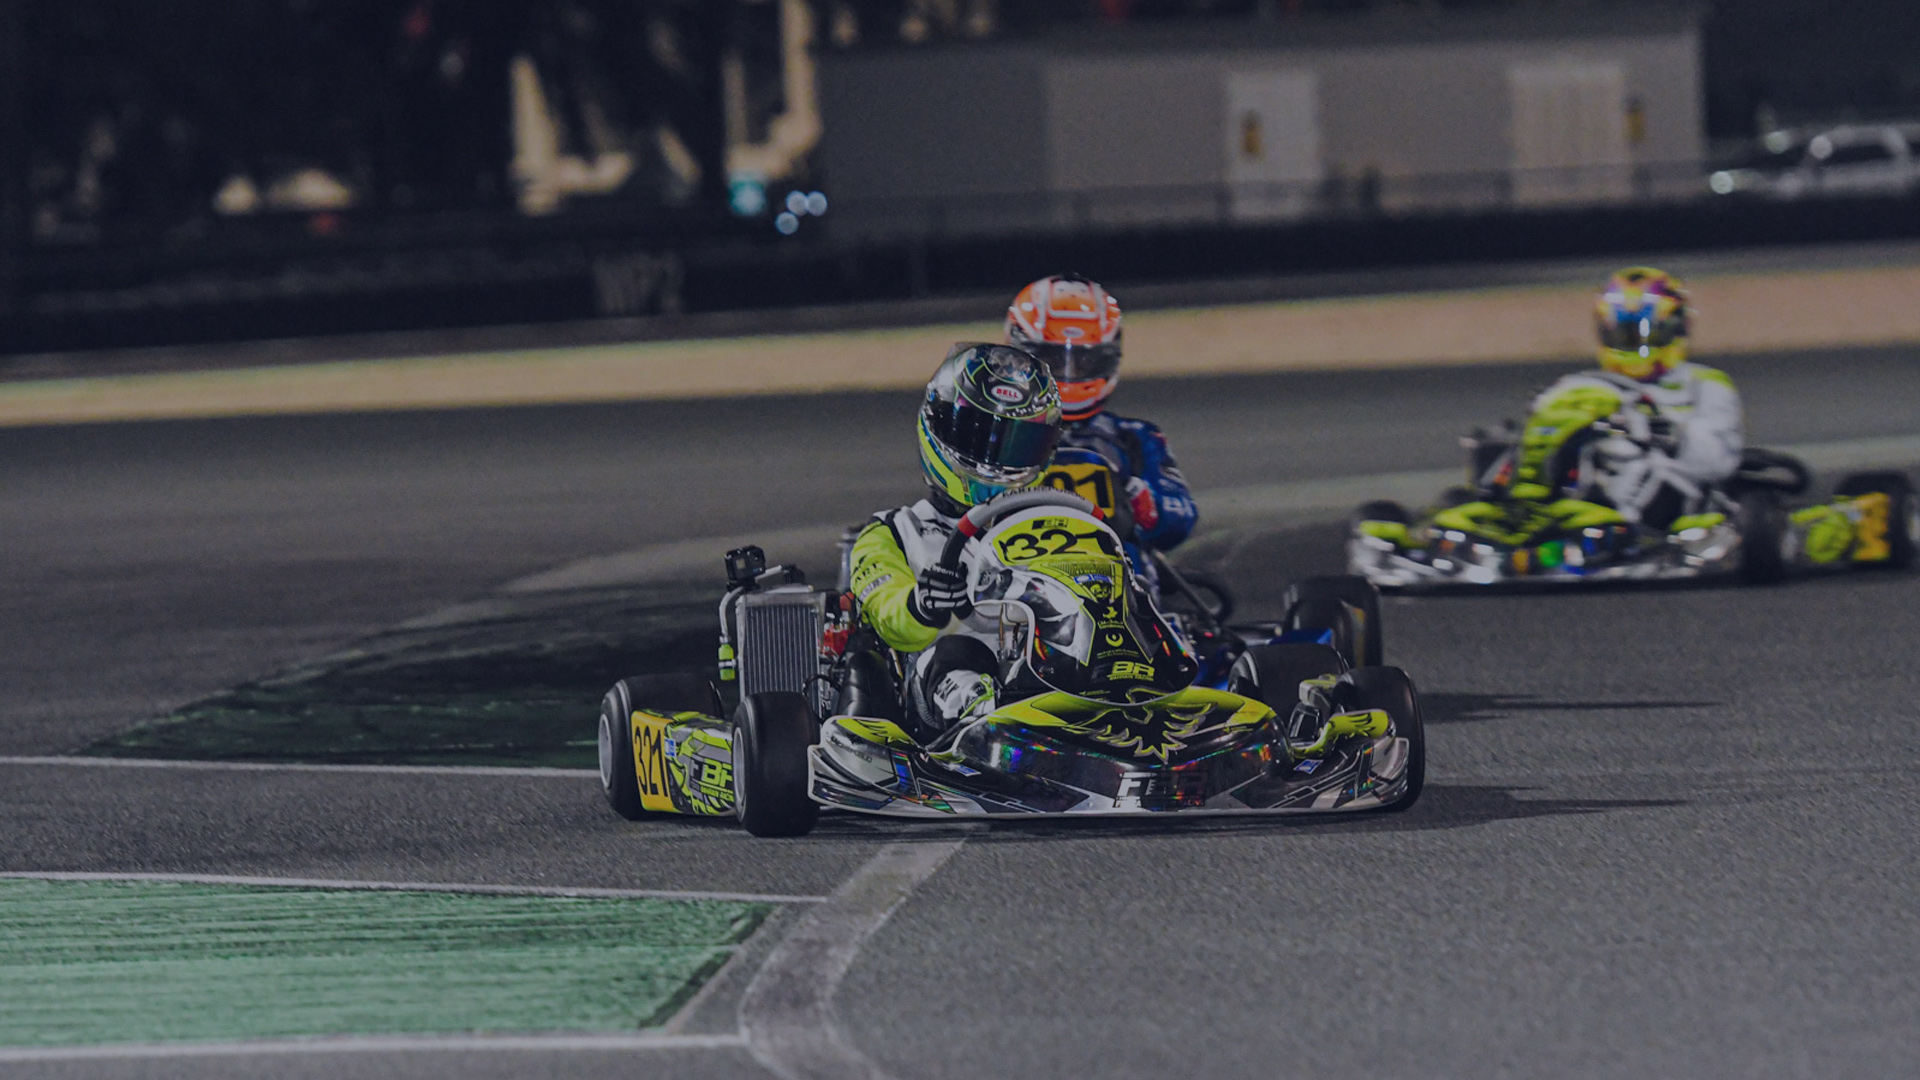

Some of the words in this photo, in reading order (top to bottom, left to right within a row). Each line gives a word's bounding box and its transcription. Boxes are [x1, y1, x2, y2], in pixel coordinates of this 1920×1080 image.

[996, 388, 1019, 399] BELL
[1004, 529, 1120, 560] 321
[634, 726, 668, 797] 321
